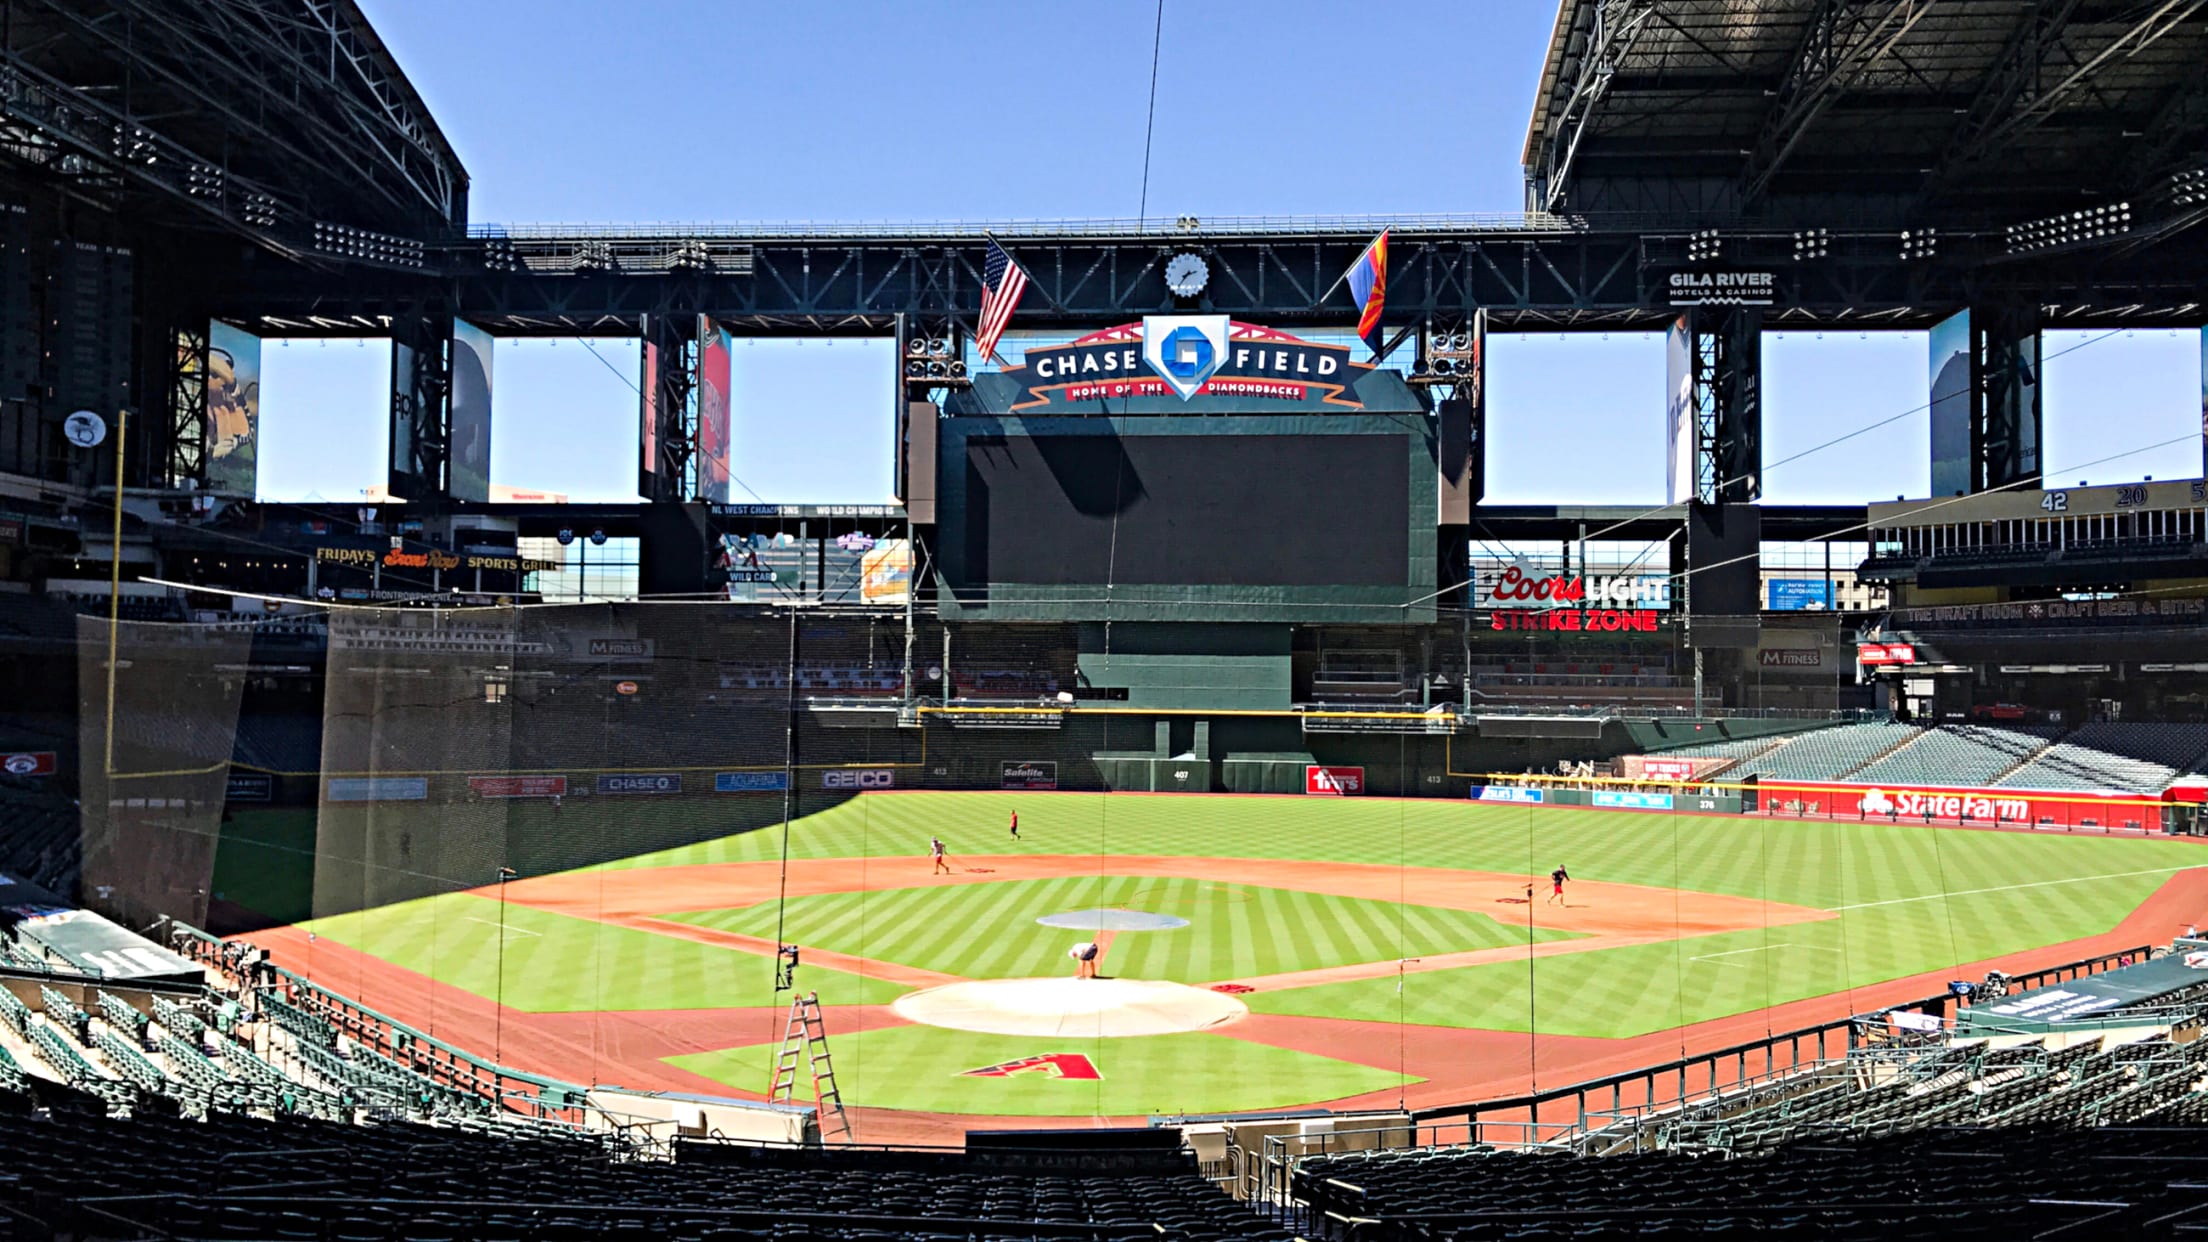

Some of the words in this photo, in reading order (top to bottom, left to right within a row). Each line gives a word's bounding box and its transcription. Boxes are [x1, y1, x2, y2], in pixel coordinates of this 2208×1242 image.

[1669, 273, 1713, 286] GILA
[1716, 272, 1772, 286] RIVER
[1036, 350, 1138, 379] CHASE
[1236, 349, 1338, 376] FIELD
[1071, 385, 1107, 397] HOME
[1115, 384, 1132, 394] OF
[1139, 382, 1163, 393] THE
[1207, 382, 1301, 397] DIAMONDBACKS
[2041, 491, 2069, 512] 42
[2115, 486, 2148, 508] 20
[711, 505, 723, 514] NL
[725, 505, 748, 514] WEST
[753, 506, 799, 515] CHAMPIONS
[816, 506, 844, 515] WORLD
[846, 506, 894, 515] CHAMPIONS
[468, 556, 518, 571] SPORTS
[522, 558, 557, 571] GRILL
[730, 572, 751, 582] WILD
[754, 572, 777, 582] CARD
[1492, 566, 1585, 601] Coors
[1586, 575, 1669, 601] LIGHT
[1908, 609, 1933, 622] THE
[1935, 607, 1980, 622] DRAFT
[1982, 604, 2024, 620] ROOM
[2048, 602, 2095, 618] CRAFT
[2098, 600, 2137, 616] BEER
[2142, 604, 2157, 615] &
[2160, 599, 2206, 615] BITES
[1491, 609, 1581, 631] STRIKE
[1585, 610, 1658, 631] ZONE
[1763, 652, 1781, 665] M
[1783, 654, 1819, 665] FITNESS
[933, 767, 947, 776] 413
[1004, 768, 1044, 777] Safelite
[1173, 771, 1189, 779] 407
[609, 779, 657, 789] CHASE
[730, 774, 778, 786] AQUAFINA
[824, 770, 893, 787] GEICO
[1427, 775, 1441, 784] 413
